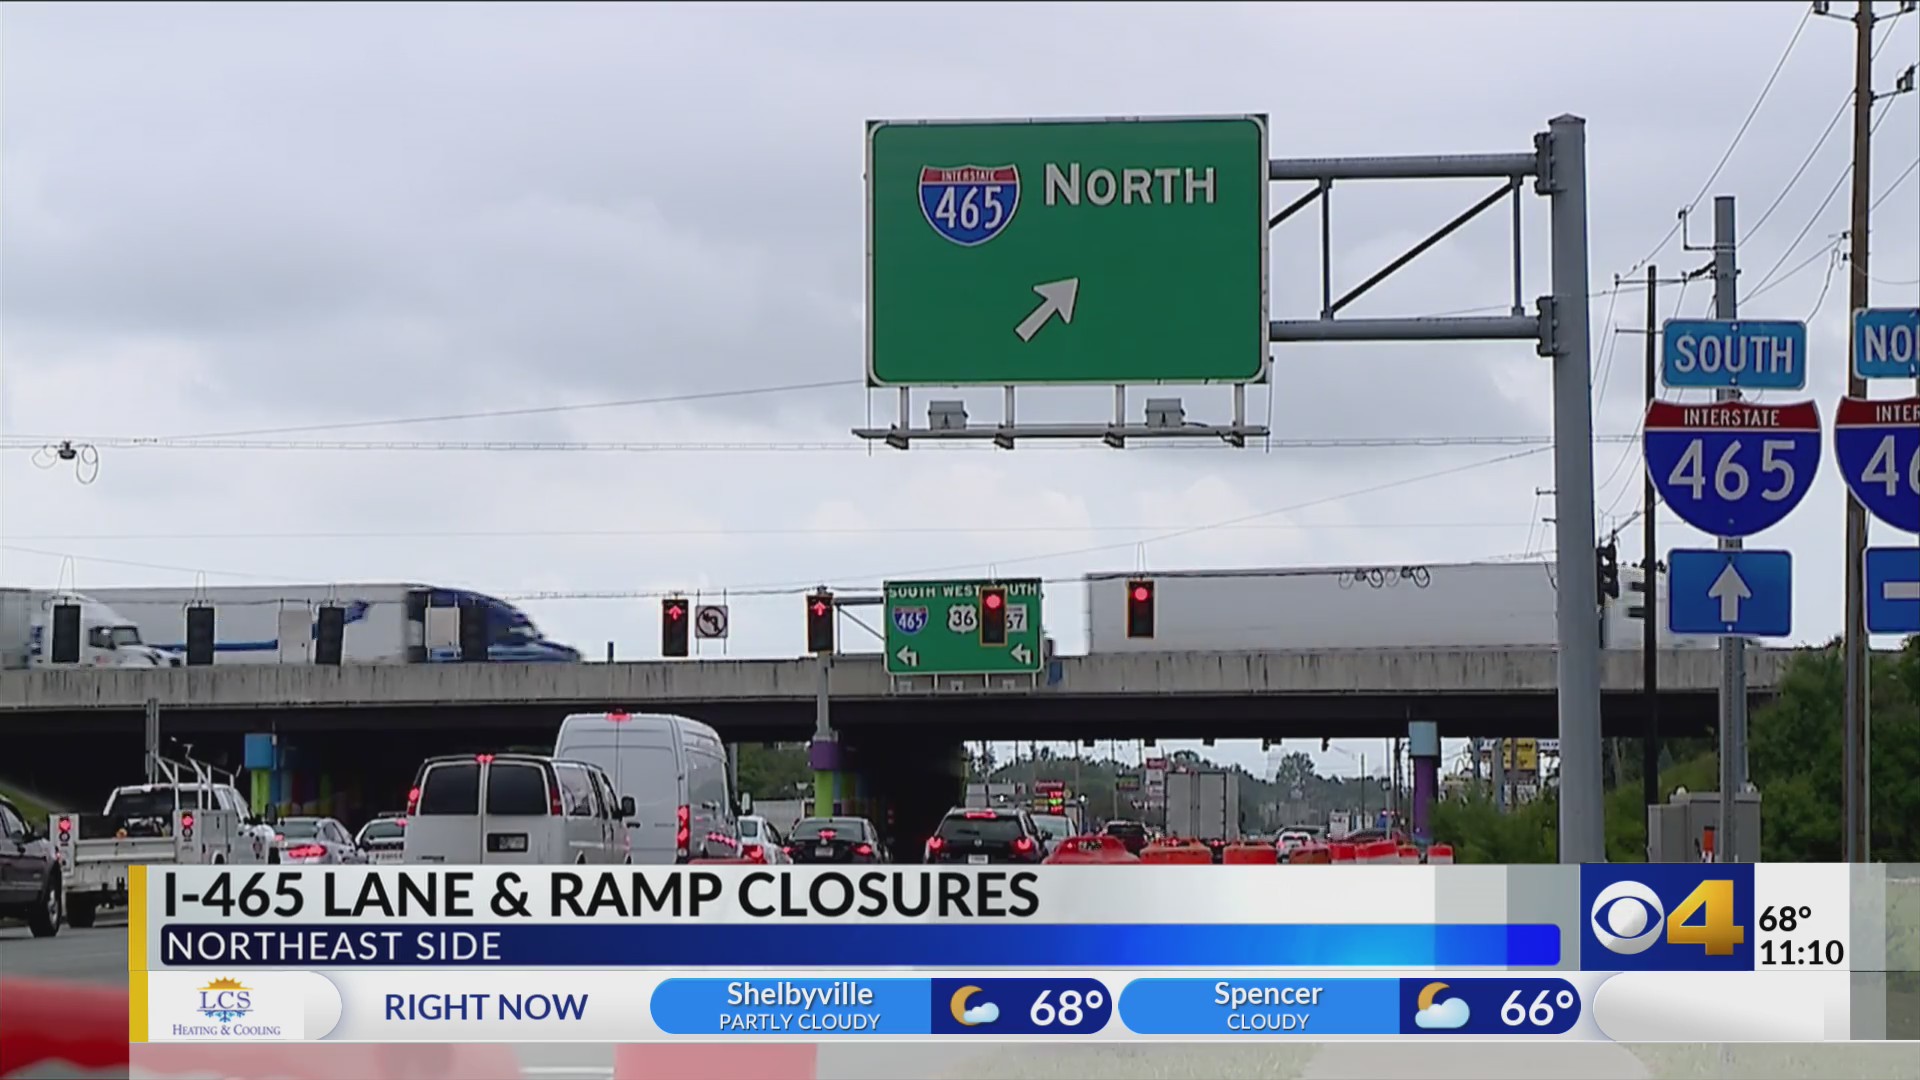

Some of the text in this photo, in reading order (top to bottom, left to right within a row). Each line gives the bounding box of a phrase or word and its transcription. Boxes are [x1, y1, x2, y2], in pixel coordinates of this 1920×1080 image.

[941, 170, 995, 182] INTERSTATE
[935, 162, 1217, 230] 465 NORTH
[1674, 336, 1793, 374] SOUTH
[1864, 324, 1920, 363] NO
[1684, 408, 1781, 427] INTERSTATE
[1668, 438, 1796, 501] 465
[889, 582, 1038, 598] SOUTH WEST UTH
[898, 612, 924, 630] 465
[953, 610, 975, 627] 36
